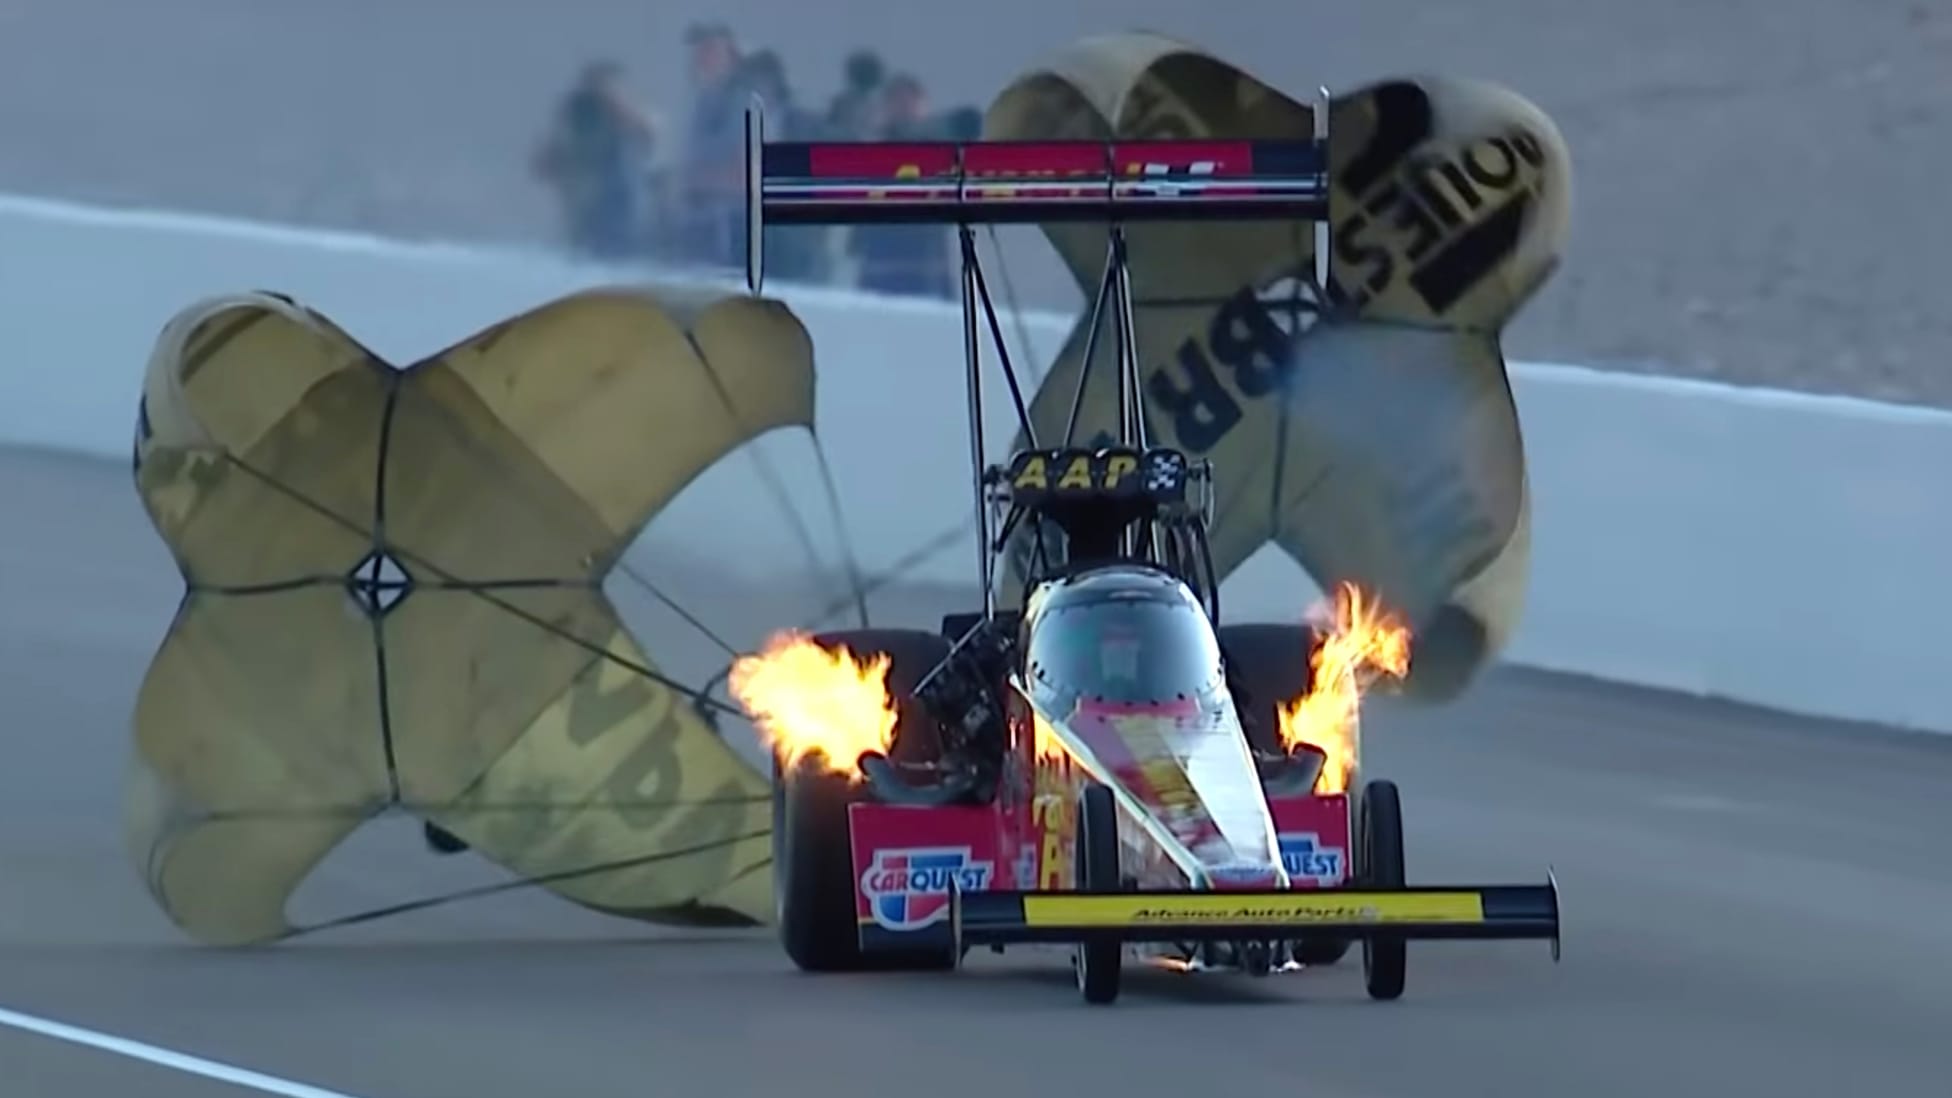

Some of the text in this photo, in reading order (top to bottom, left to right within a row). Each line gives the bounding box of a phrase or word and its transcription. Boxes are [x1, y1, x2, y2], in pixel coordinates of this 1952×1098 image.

[1014, 456, 1137, 489] AAP
[1283, 853, 1338, 876] UEST
[1232, 906, 1290, 918] Auto
